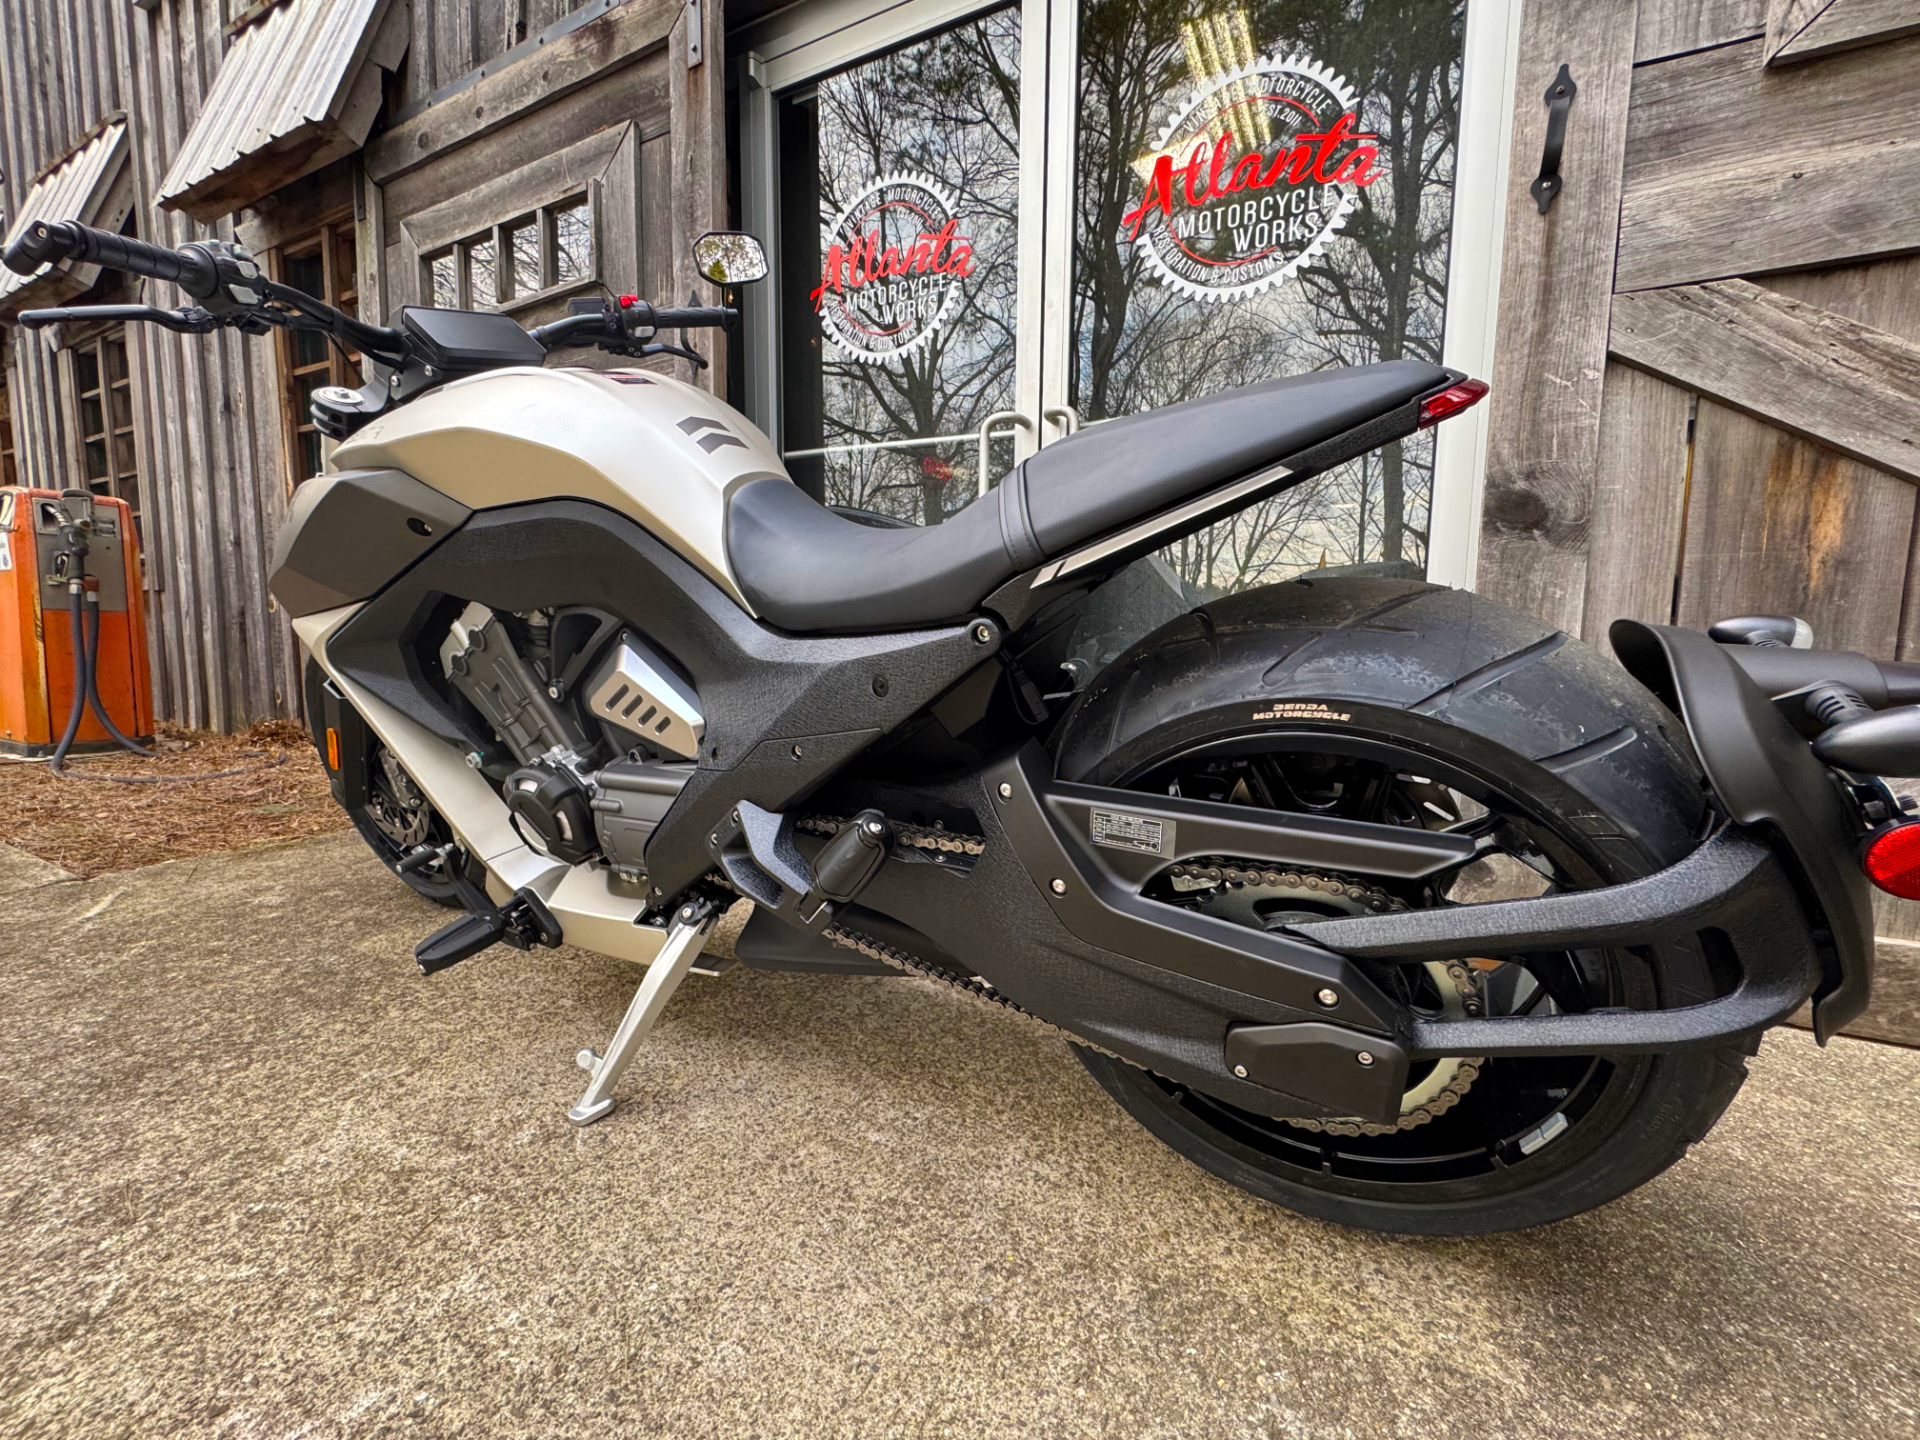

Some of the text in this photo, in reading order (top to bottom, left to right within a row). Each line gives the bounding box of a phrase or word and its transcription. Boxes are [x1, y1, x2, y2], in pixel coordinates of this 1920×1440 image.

[1123, 112, 1384, 241] Atlanta
[845, 187, 942, 229] VINTAGE MOTORCYCLE
[1177, 182, 1336, 239] MOTORCYCLE
[1233, 211, 1321, 252] WORKS
[809, 218, 978, 313] Atlanta
[1153, 225, 1285, 284] RESTORATION & CUSTOMS
[846, 271, 948, 313] MOTORCYCLE
[882, 295, 938, 325] WORKS
[828, 301, 869, 348] RESTORATION
